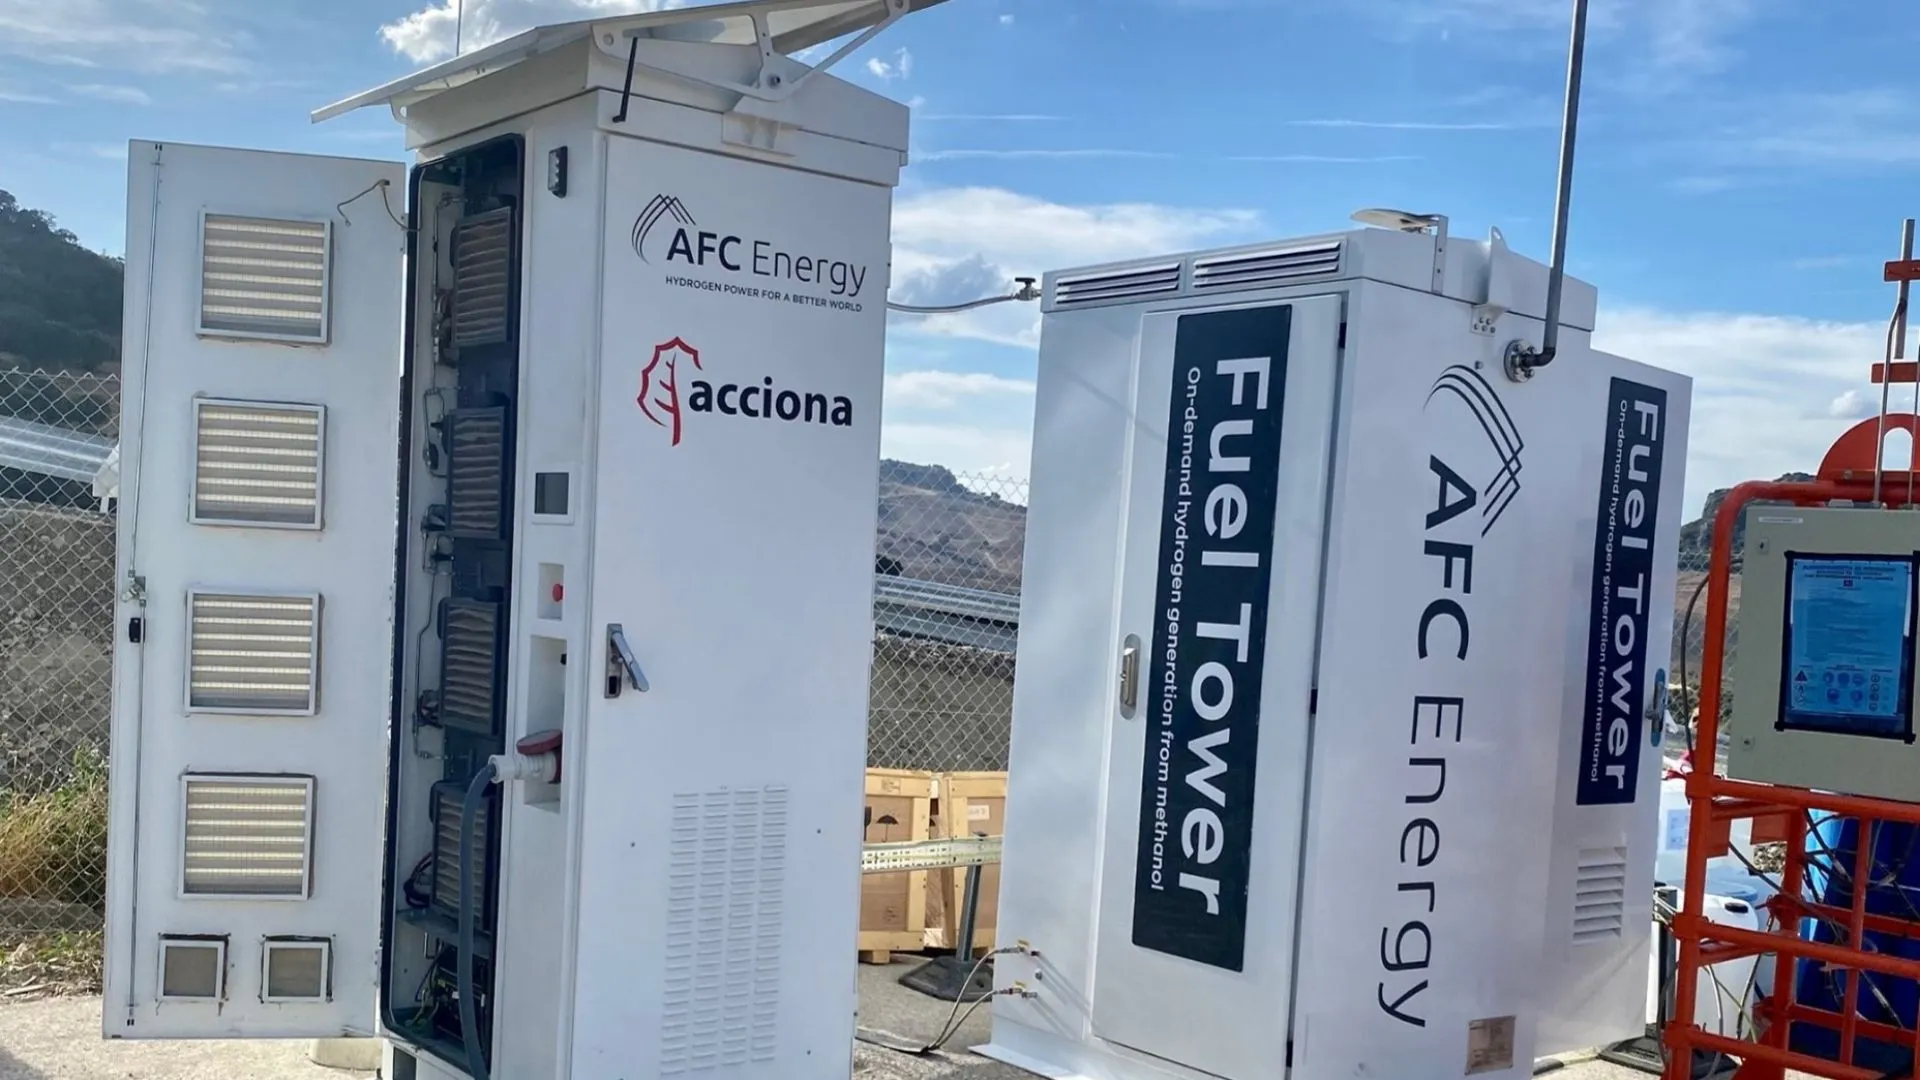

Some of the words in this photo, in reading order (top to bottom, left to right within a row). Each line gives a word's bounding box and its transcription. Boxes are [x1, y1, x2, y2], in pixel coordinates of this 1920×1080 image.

[665, 276, 722, 292] HYDROGEN
[724, 284, 760, 298] POWER
[762, 290, 782, 301] FOR
[784, 293, 792, 302] A
[793, 294, 828, 308] BETTER
[829, 299, 863, 313] WORLD
[666, 227, 742, 272] AFC
[752, 240, 866, 297] Energy
[688, 376, 853, 426] acciona
[1179, 366, 1201, 497] On-demand
[1612, 399, 1627, 495] On-demand
[1201, 356, 1271, 568] Fuel
[1621, 400, 1659, 550] Fuel
[1170, 501, 1192, 603] hydrogen
[1417, 454, 1477, 661] AFC
[1604, 497, 1619, 572] hydrogen
[1162, 605, 1181, 726] generation
[1599, 574, 1612, 663] generation
[1596, 666, 1607, 706] from
[1605, 573, 1644, 790] Tower
[1157, 730, 1175, 783] from
[1178, 603, 1252, 916] Tower
[1591, 707, 1604, 782] methanol
[1151, 787, 1168, 891] methanol
[1378, 695, 1464, 1028] Energy
